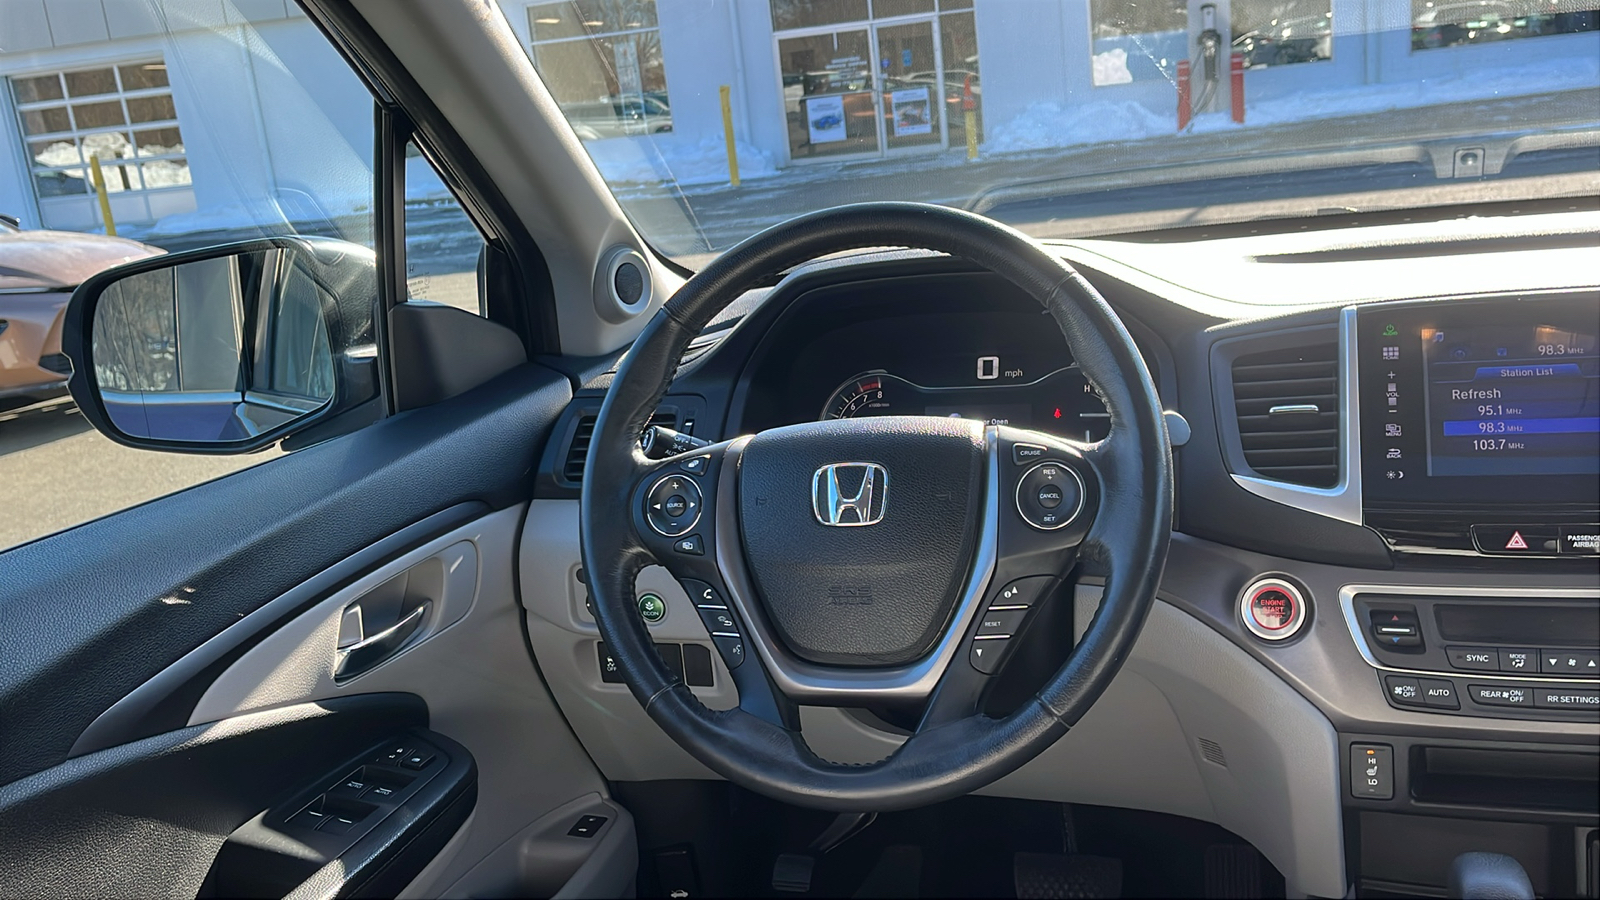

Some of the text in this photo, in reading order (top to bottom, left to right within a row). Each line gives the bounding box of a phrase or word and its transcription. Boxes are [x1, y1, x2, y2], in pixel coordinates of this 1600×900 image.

[1538, 345, 1565, 355] 98.3
[977, 356, 1023, 380] 0 mph
[1500, 368, 1553, 377] Station List
[1084, 384, 1091, 393] H
[877, 391, 883, 399] 8
[1452, 389, 1501, 400] Refresh
[1478, 405, 1503, 416] 95.1
[991, 418, 1009, 426] Open
[1479, 422, 1505, 433] 98.3
[1473, 439, 1506, 450] 103.7
[1466, 654, 1489, 662] SYNC
[1428, 688, 1450, 697] AUTO
[1480, 690, 1502, 699] REAR
[1509, 695, 1524, 703] OFF
[1547, 695, 1600, 704] RR SETTINGS
